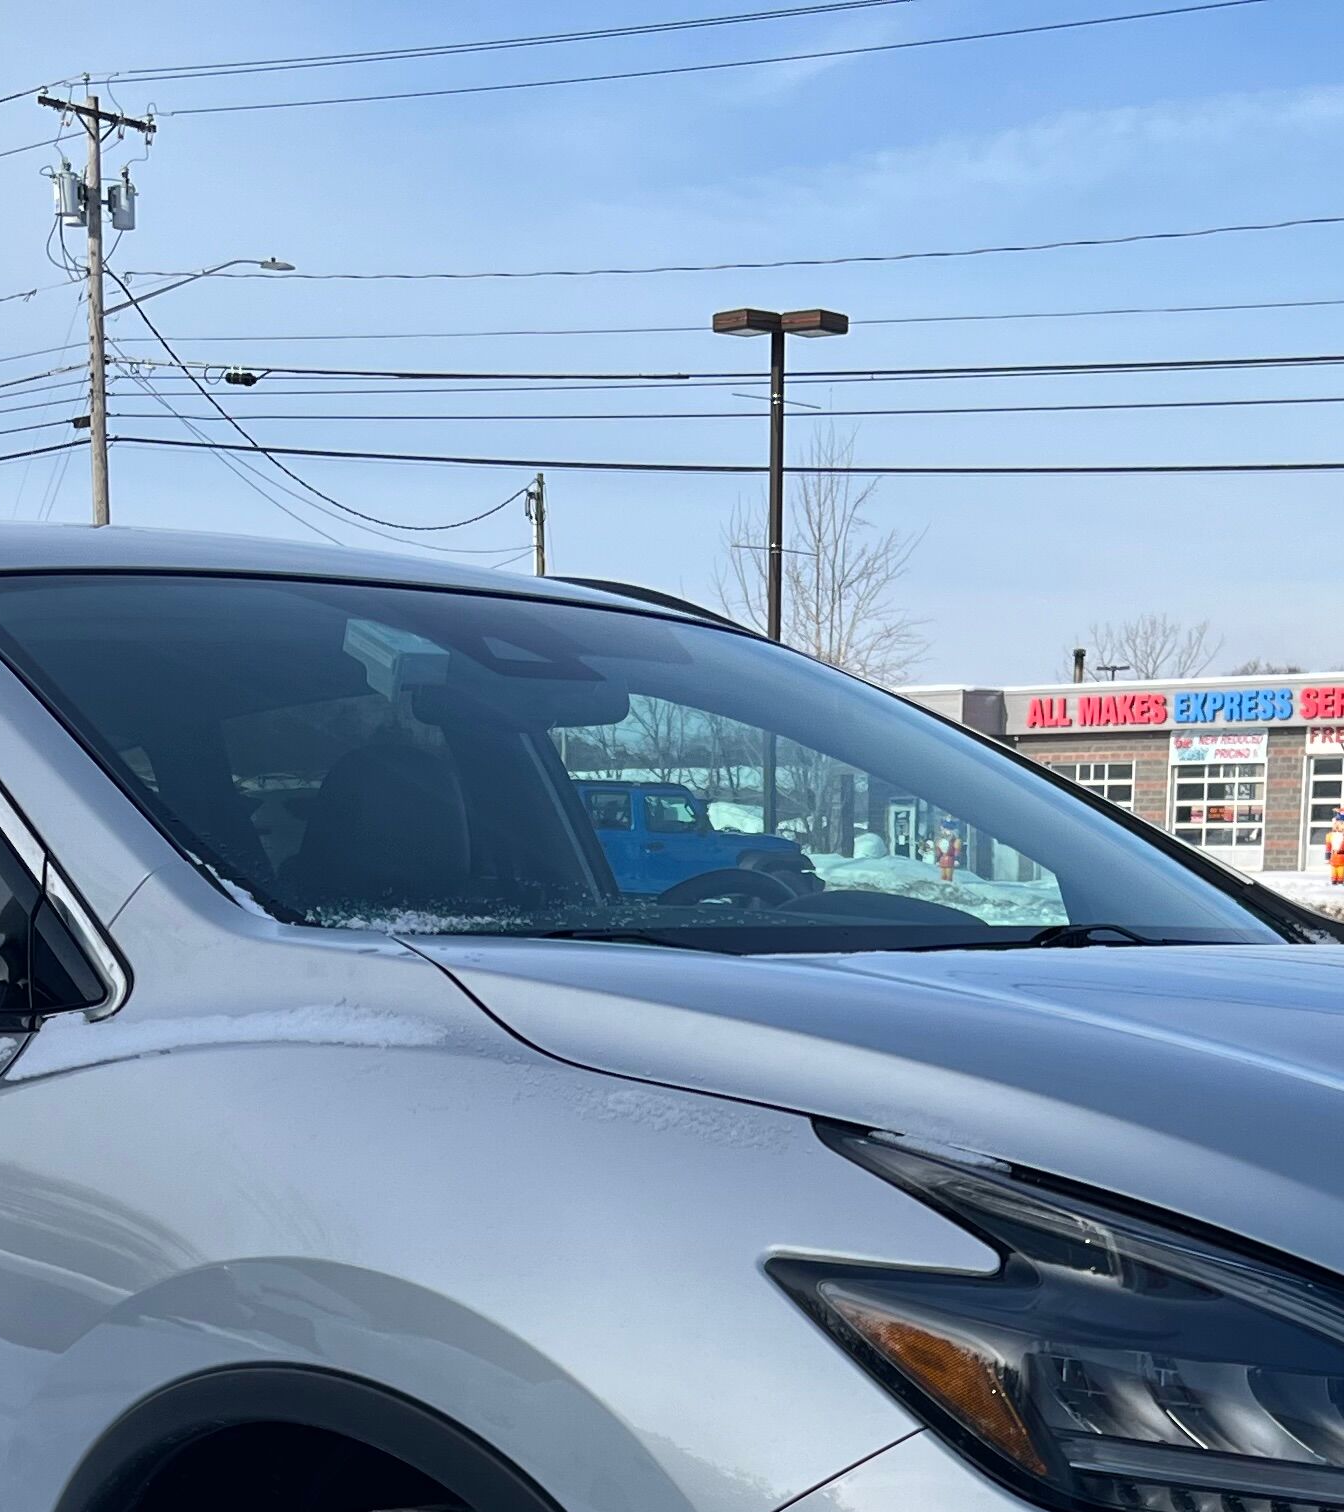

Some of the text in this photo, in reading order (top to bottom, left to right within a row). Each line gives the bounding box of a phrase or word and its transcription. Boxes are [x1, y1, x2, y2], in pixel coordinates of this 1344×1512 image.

[1027, 695, 1072, 728] ALL
[1077, 692, 1168, 726] MAKES
[1174, 688, 1293, 723] EXPRESS
